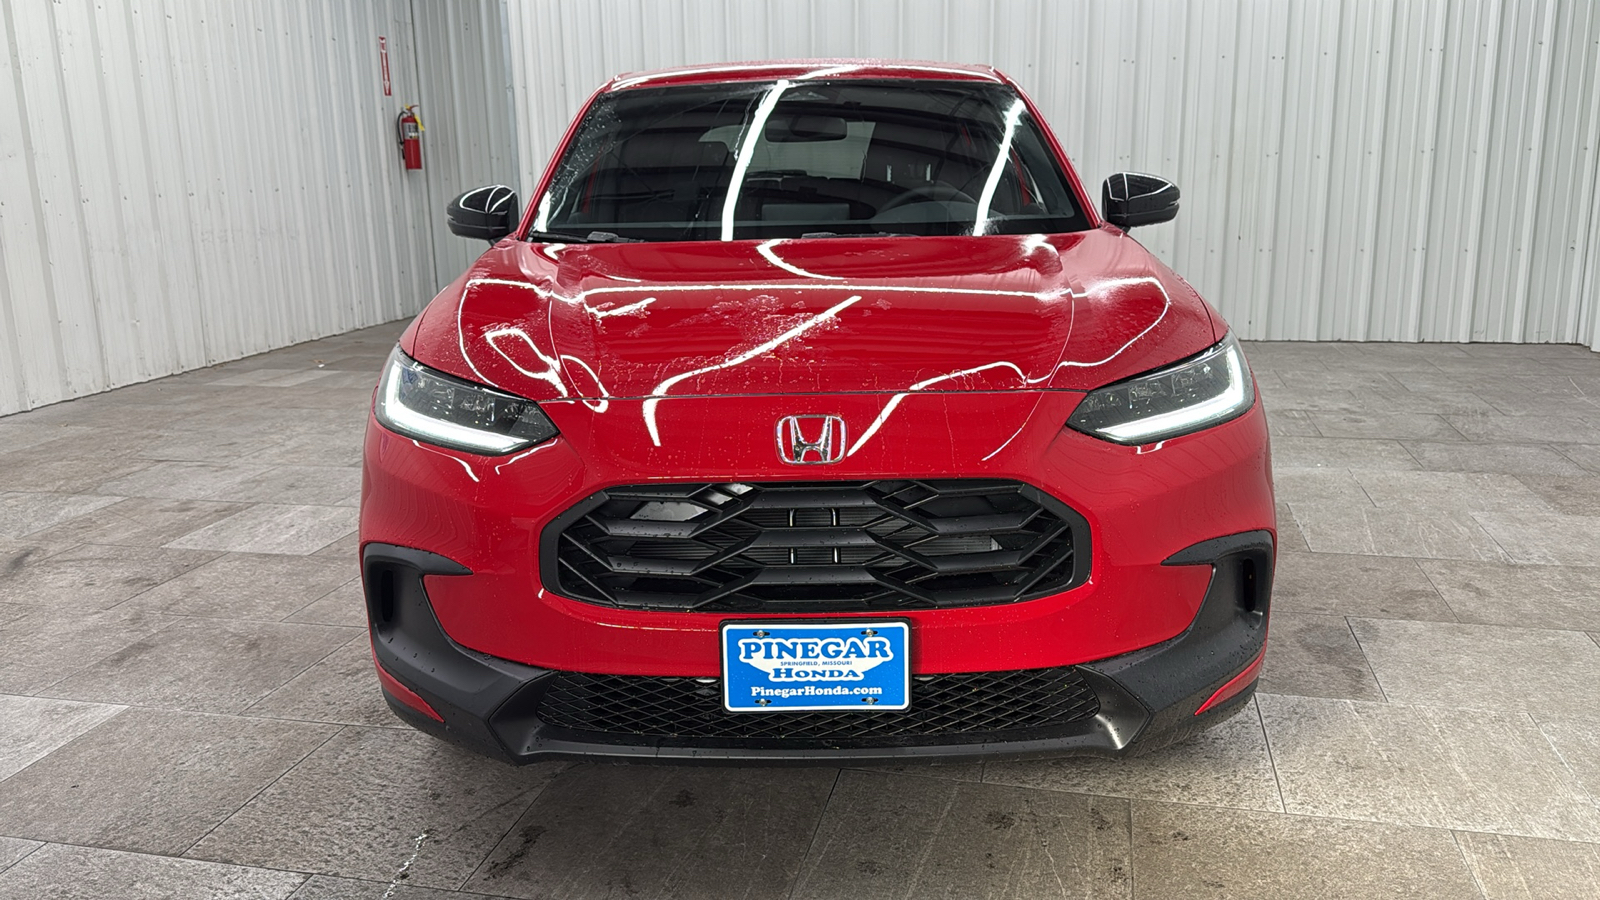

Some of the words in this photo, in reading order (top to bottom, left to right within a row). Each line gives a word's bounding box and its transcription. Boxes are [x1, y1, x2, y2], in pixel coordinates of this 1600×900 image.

[742, 640, 890, 660] PINEGAR
[772, 668, 861, 679] HONDA
[751, 686, 883, 698] PinegarHonda.com
